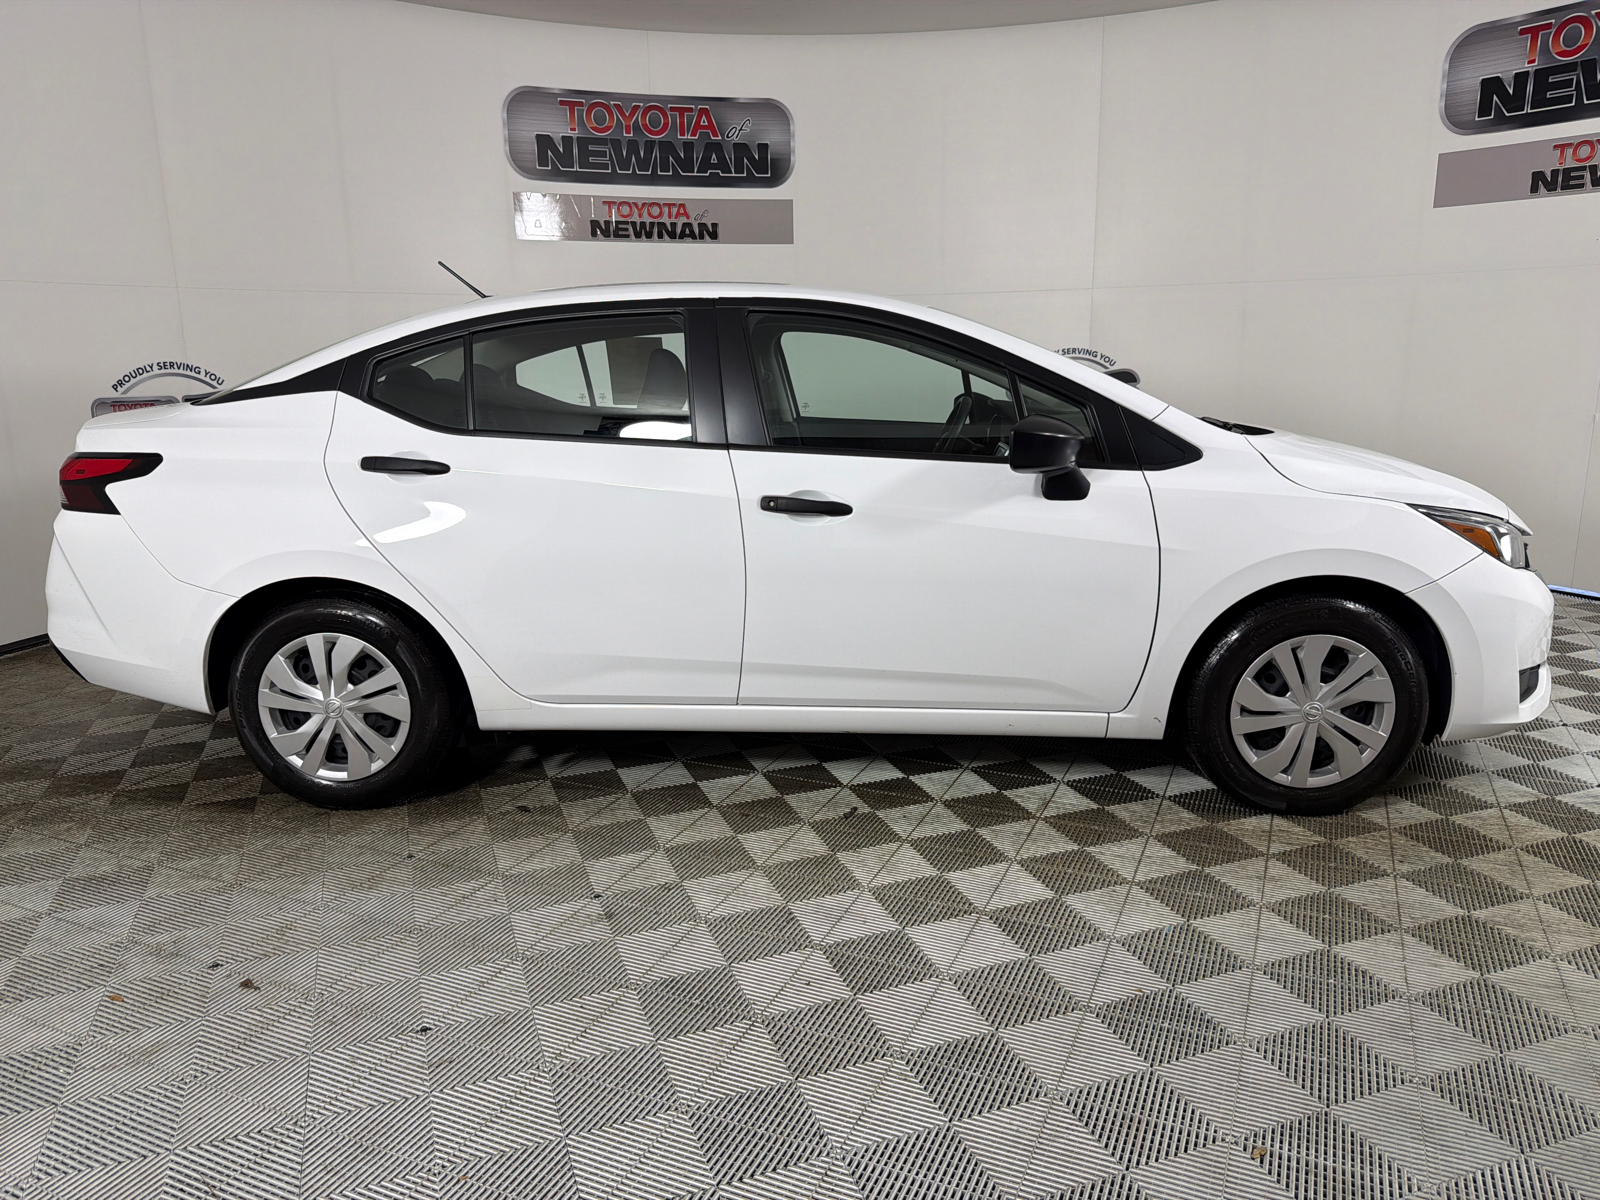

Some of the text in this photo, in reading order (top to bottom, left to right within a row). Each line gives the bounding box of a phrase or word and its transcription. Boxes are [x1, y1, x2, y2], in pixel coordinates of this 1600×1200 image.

[1518, 9, 1600, 67] TO
[557, 98, 751, 140] TOYOTA of
[535, 133, 771, 177] NEWNAN
[1552, 138, 1600, 167] TO
[602, 200, 710, 222] TOYOTA of
[589, 219, 720, 242] NEWNAN
[1061, 347, 1116, 367] SERVING YOU
[111, 361, 225, 393] PROUDLY SERVING YOU
